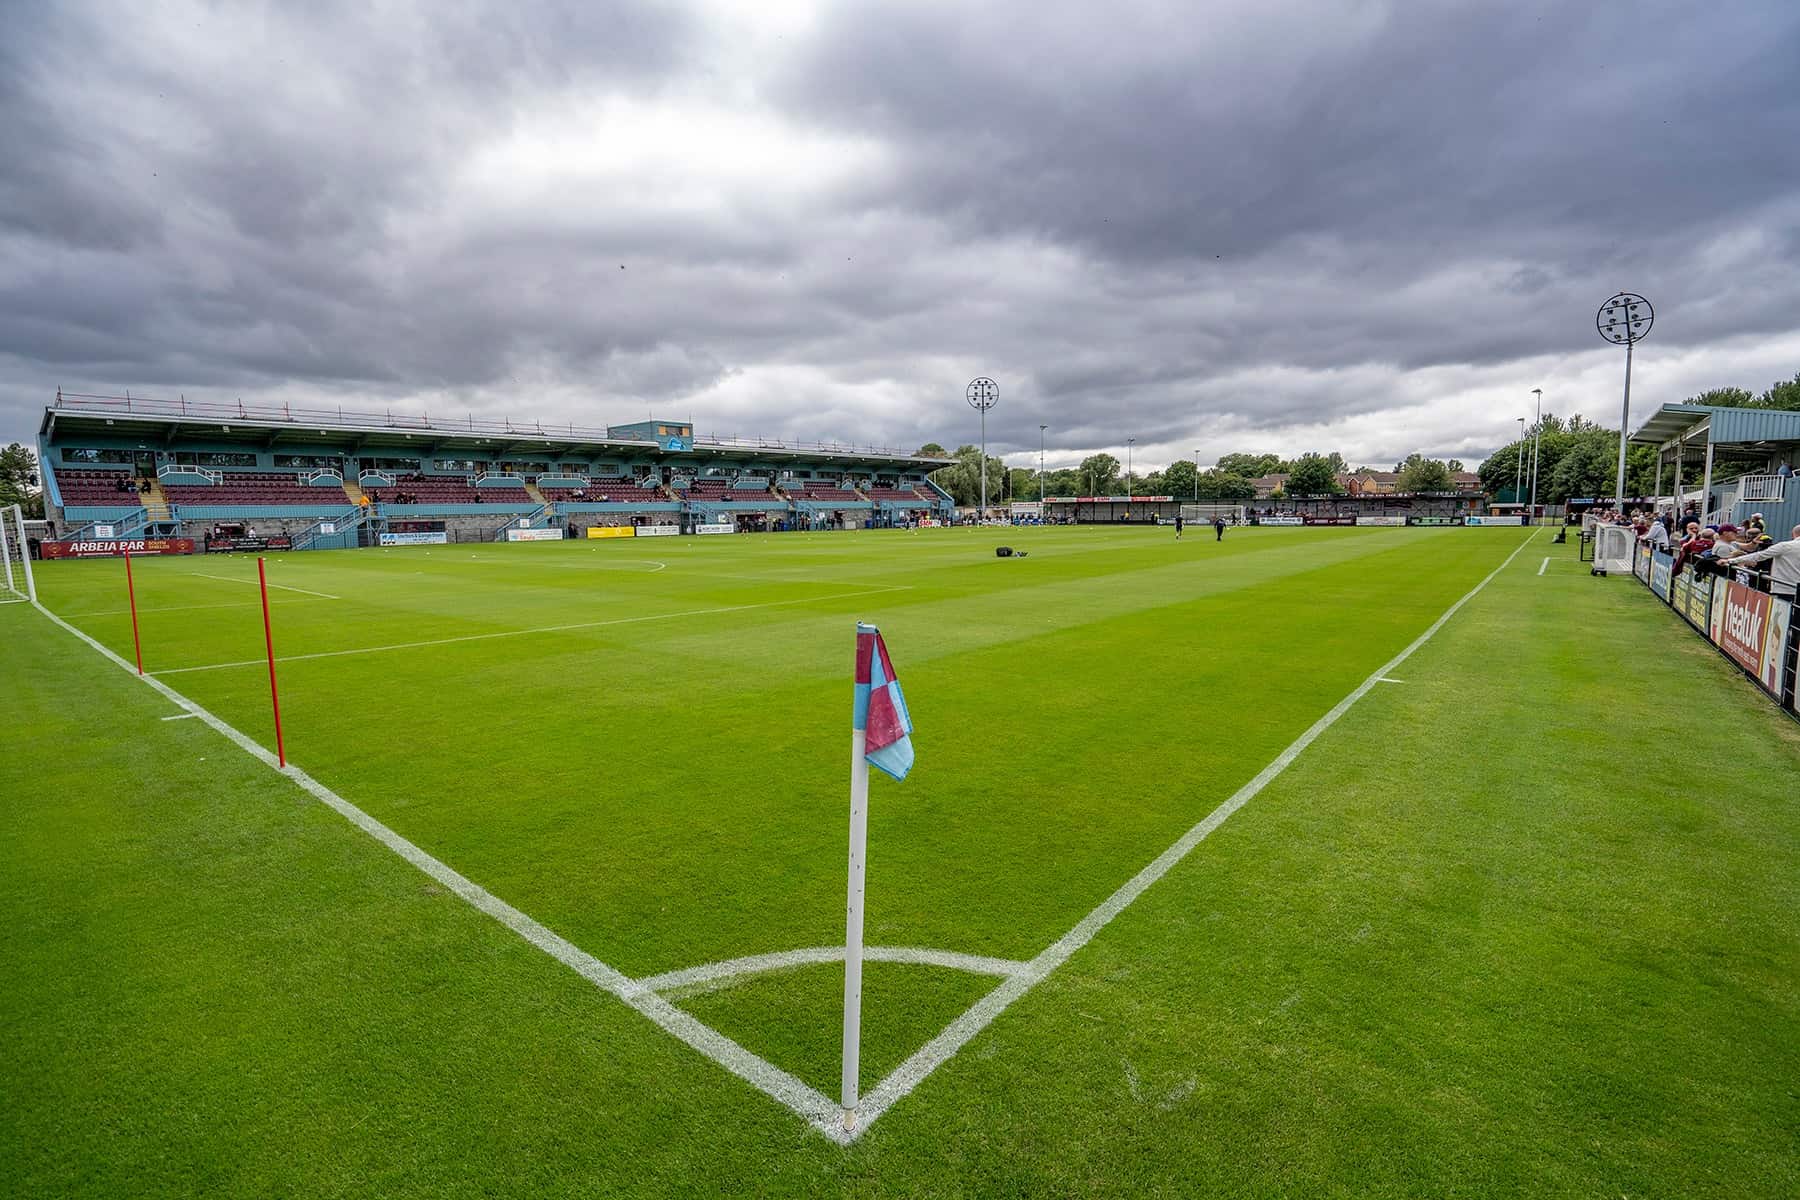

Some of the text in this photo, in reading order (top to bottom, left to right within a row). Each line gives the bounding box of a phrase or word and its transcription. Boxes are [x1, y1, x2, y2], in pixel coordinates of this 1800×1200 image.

[69, 541, 145, 552] ARBEIA BAR
[1725, 587, 1761, 652] heatuk
